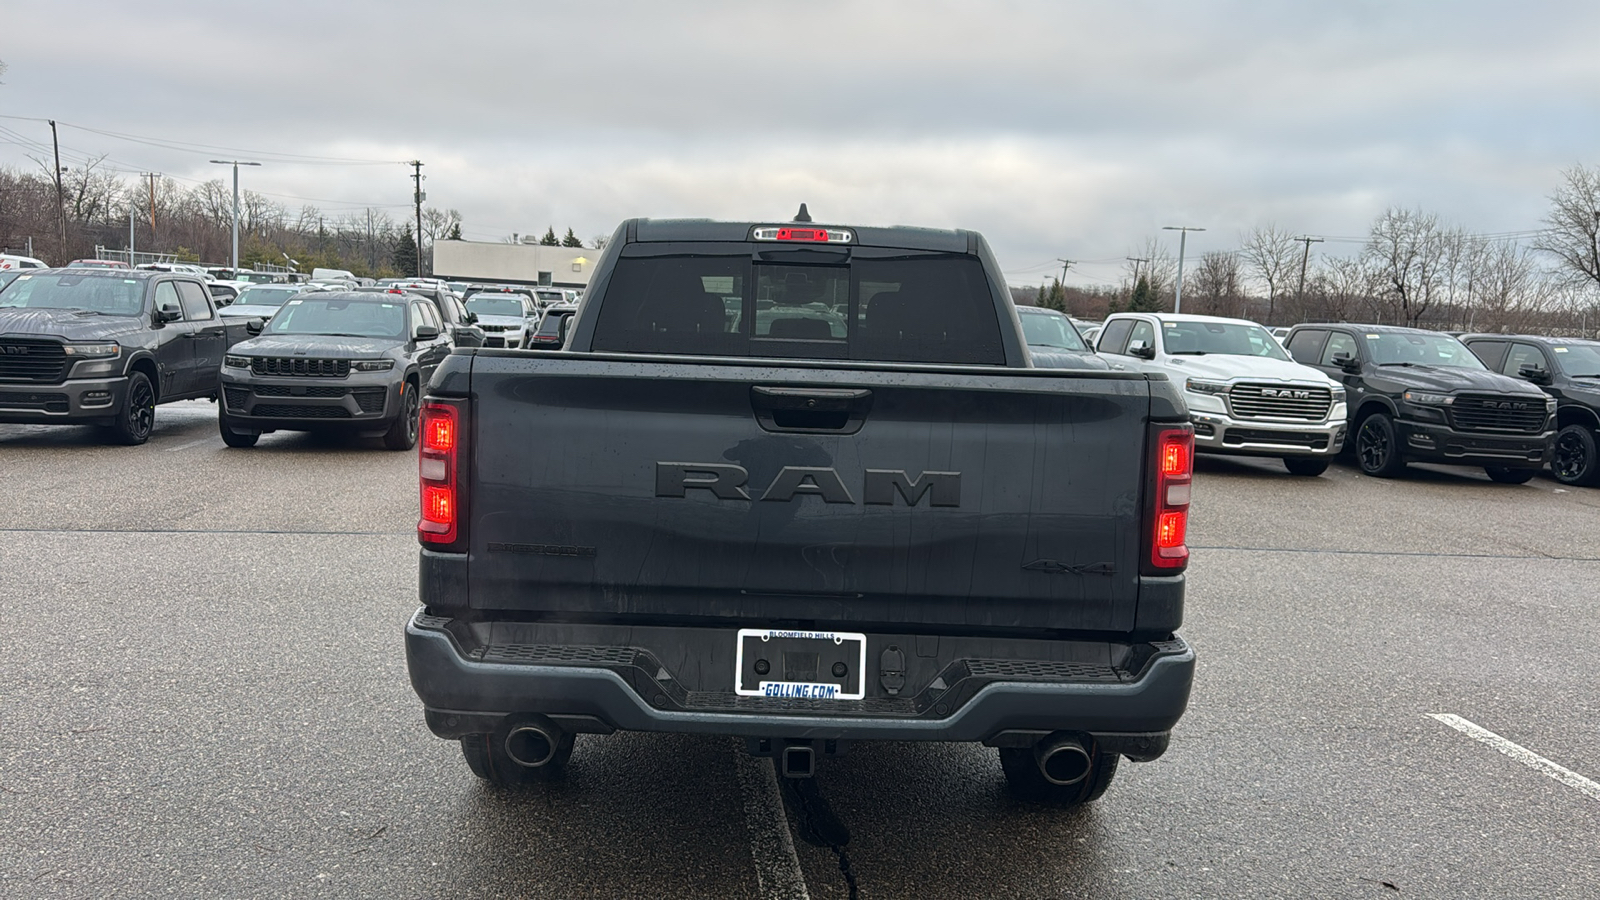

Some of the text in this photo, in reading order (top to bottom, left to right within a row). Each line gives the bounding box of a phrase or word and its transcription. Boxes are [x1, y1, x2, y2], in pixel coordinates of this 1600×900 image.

[1261, 388, 1310, 399] RAM
[1482, 401, 1528, 410] RAM
[655, 461, 962, 507] RAM
[769, 631, 814, 640] BLOOMFIELD
[765, 683, 835, 698] GOLLING.COM
